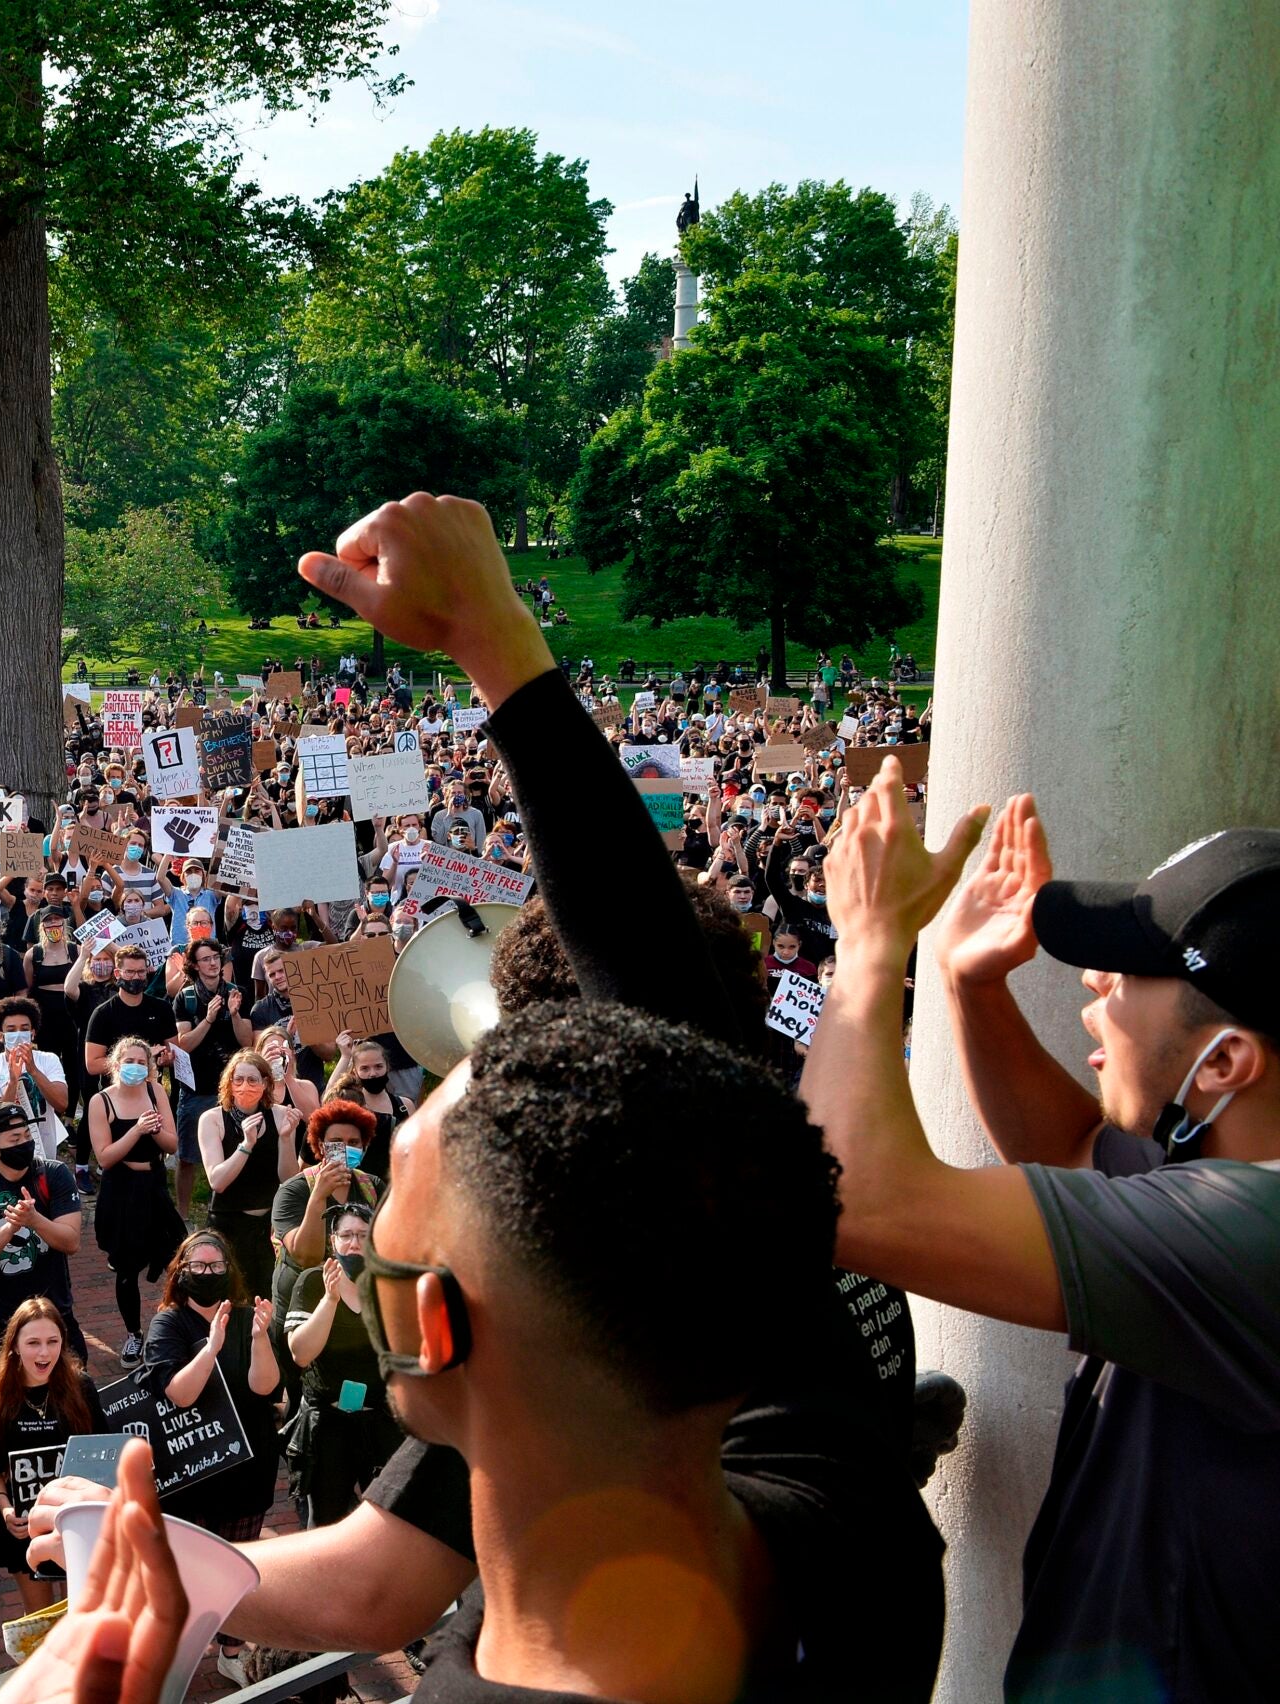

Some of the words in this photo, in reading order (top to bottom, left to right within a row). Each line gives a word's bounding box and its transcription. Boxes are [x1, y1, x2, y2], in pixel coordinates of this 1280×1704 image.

[107, 693, 140, 702] POLICE
[105, 703, 142, 712] BRUTALITY
[107, 721, 136, 731] REAL
[200, 731, 209, 741] OF
[213, 729, 223, 737] MY
[104, 732, 142, 747] TERRORISM
[204, 733, 248, 752] BROTHERS
[206, 747, 244, 765] SISTERS
[624, 749, 651, 768] BLACK
[353, 762, 376, 773] When
[207, 769, 246, 787] FEAR
[356, 787, 380, 801] LIFE
[385, 785, 396, 796] IS
[6, 834, 39, 848] BLACK
[79, 825, 125, 846] SILENCE
[6, 849, 36, 861] LIVES
[430, 845, 447, 856] HOW
[450, 852, 465, 861] CAN
[479, 862, 493, 871] CALL
[6, 860, 41, 871] MATTER
[422, 866, 439, 875] WHEN
[471, 880, 483, 888] 5%
[446, 860, 467, 874] LAND
[469, 867, 480, 878] OF
[482, 871, 497, 884] THE
[497, 874, 525, 892] FREE
[474, 889, 490, 898] 21%
[283, 949, 364, 987] BLAME
[368, 960, 388, 974] THE
[289, 977, 370, 1012] SYSTEM
[299, 1016, 319, 1026] THE
[769, 1005, 809, 1039] they
[103, 1399, 130, 1417] WHITE
[162, 1409, 202, 1434] LIVES
[167, 1420, 225, 1455] MATTER
